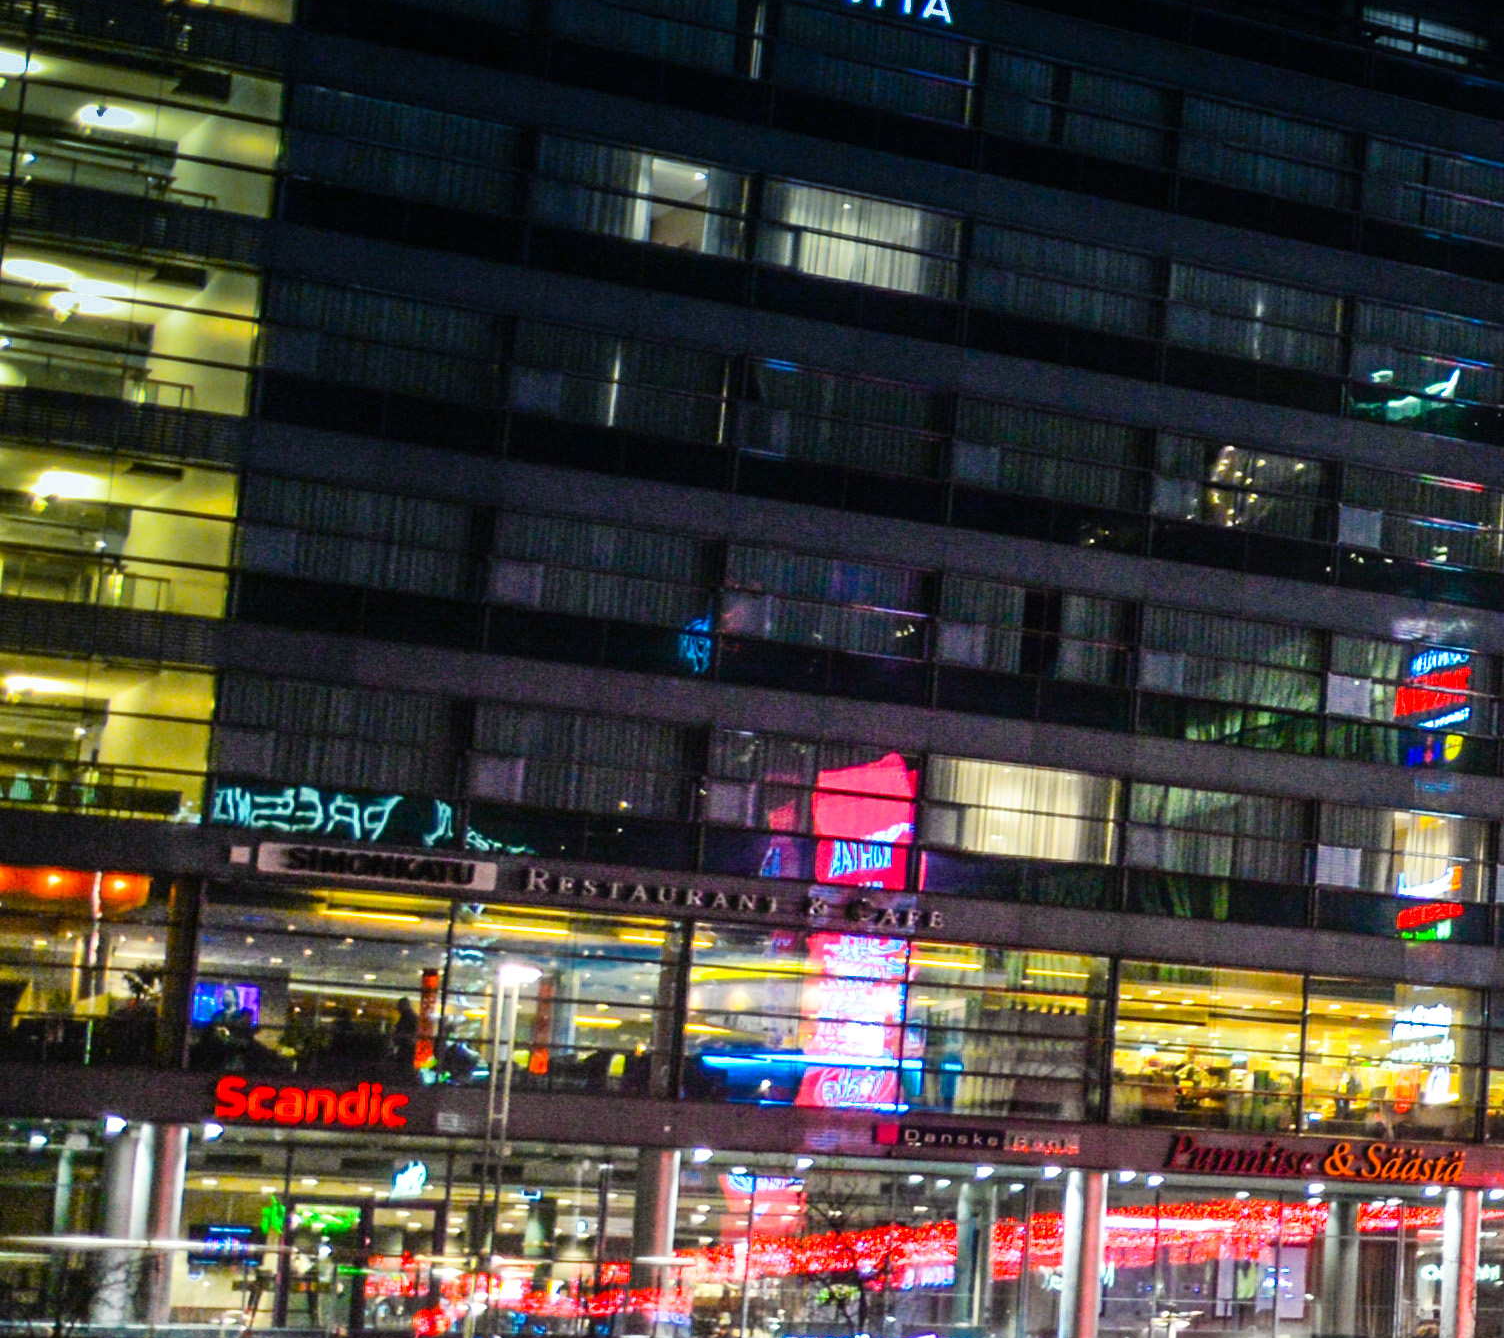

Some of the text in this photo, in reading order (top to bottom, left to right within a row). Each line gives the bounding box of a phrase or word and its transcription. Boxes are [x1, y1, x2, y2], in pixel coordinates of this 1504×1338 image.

[523, 867, 779, 913] RESTAURANT
[215, 1074, 410, 1128] Scandic
[904, 1127, 999, 1150] Danske
[1322, 1141, 1355, 1177] &
[1359, 1141, 1468, 1183] Säästä
